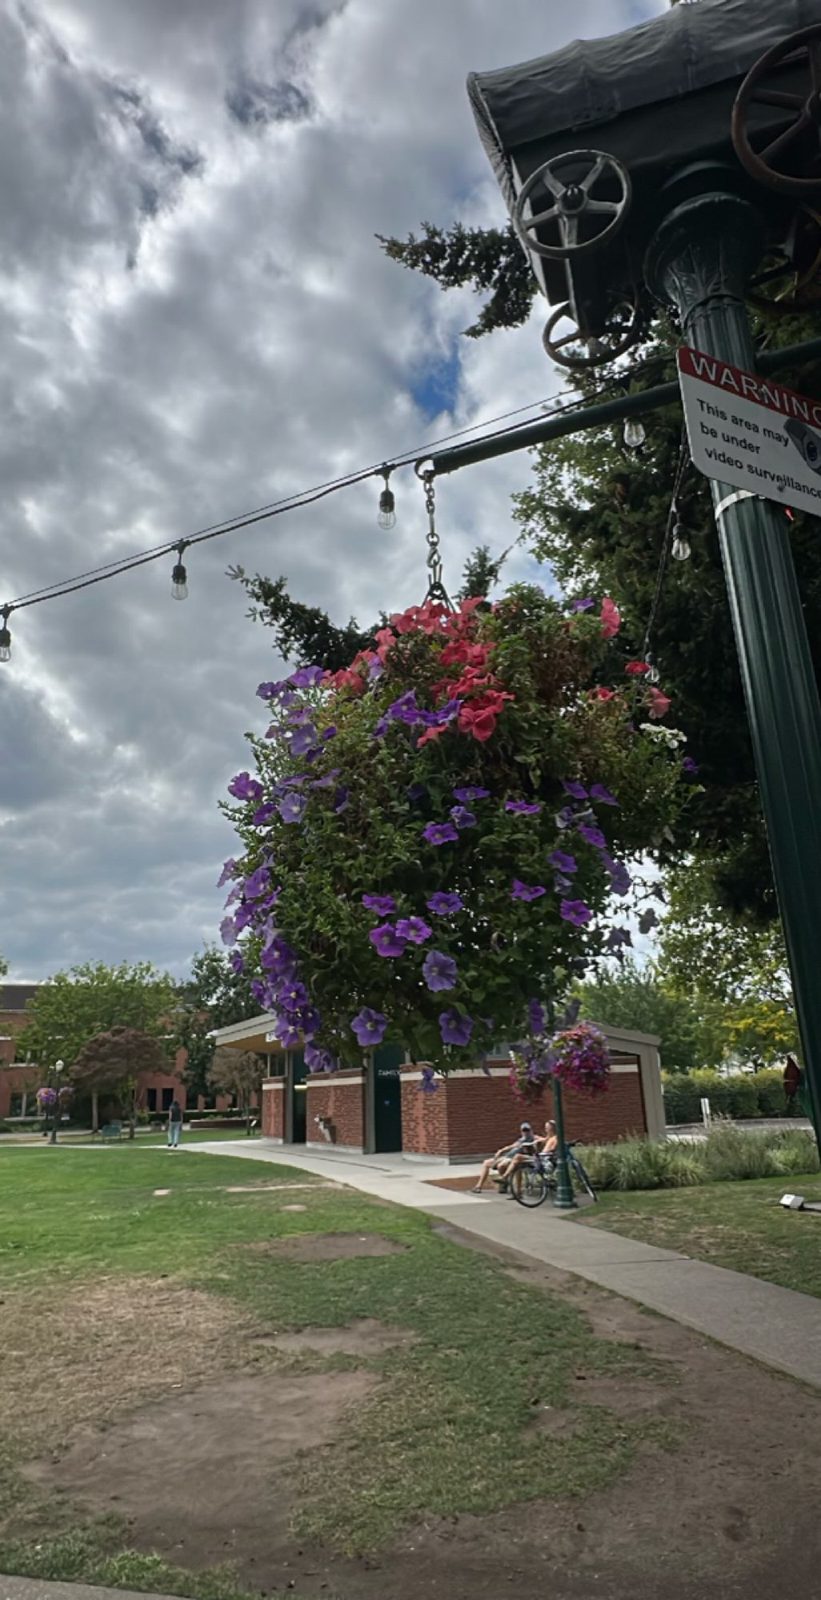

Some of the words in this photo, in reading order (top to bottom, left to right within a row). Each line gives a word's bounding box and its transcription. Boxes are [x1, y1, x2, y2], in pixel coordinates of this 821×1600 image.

[696, 398, 727, 421] This
[731, 416, 759, 433] area
[763, 428, 790, 448] may
[700, 421, 717, 439] be
[722, 432, 760, 455] under
[705, 447, 743, 470] video
